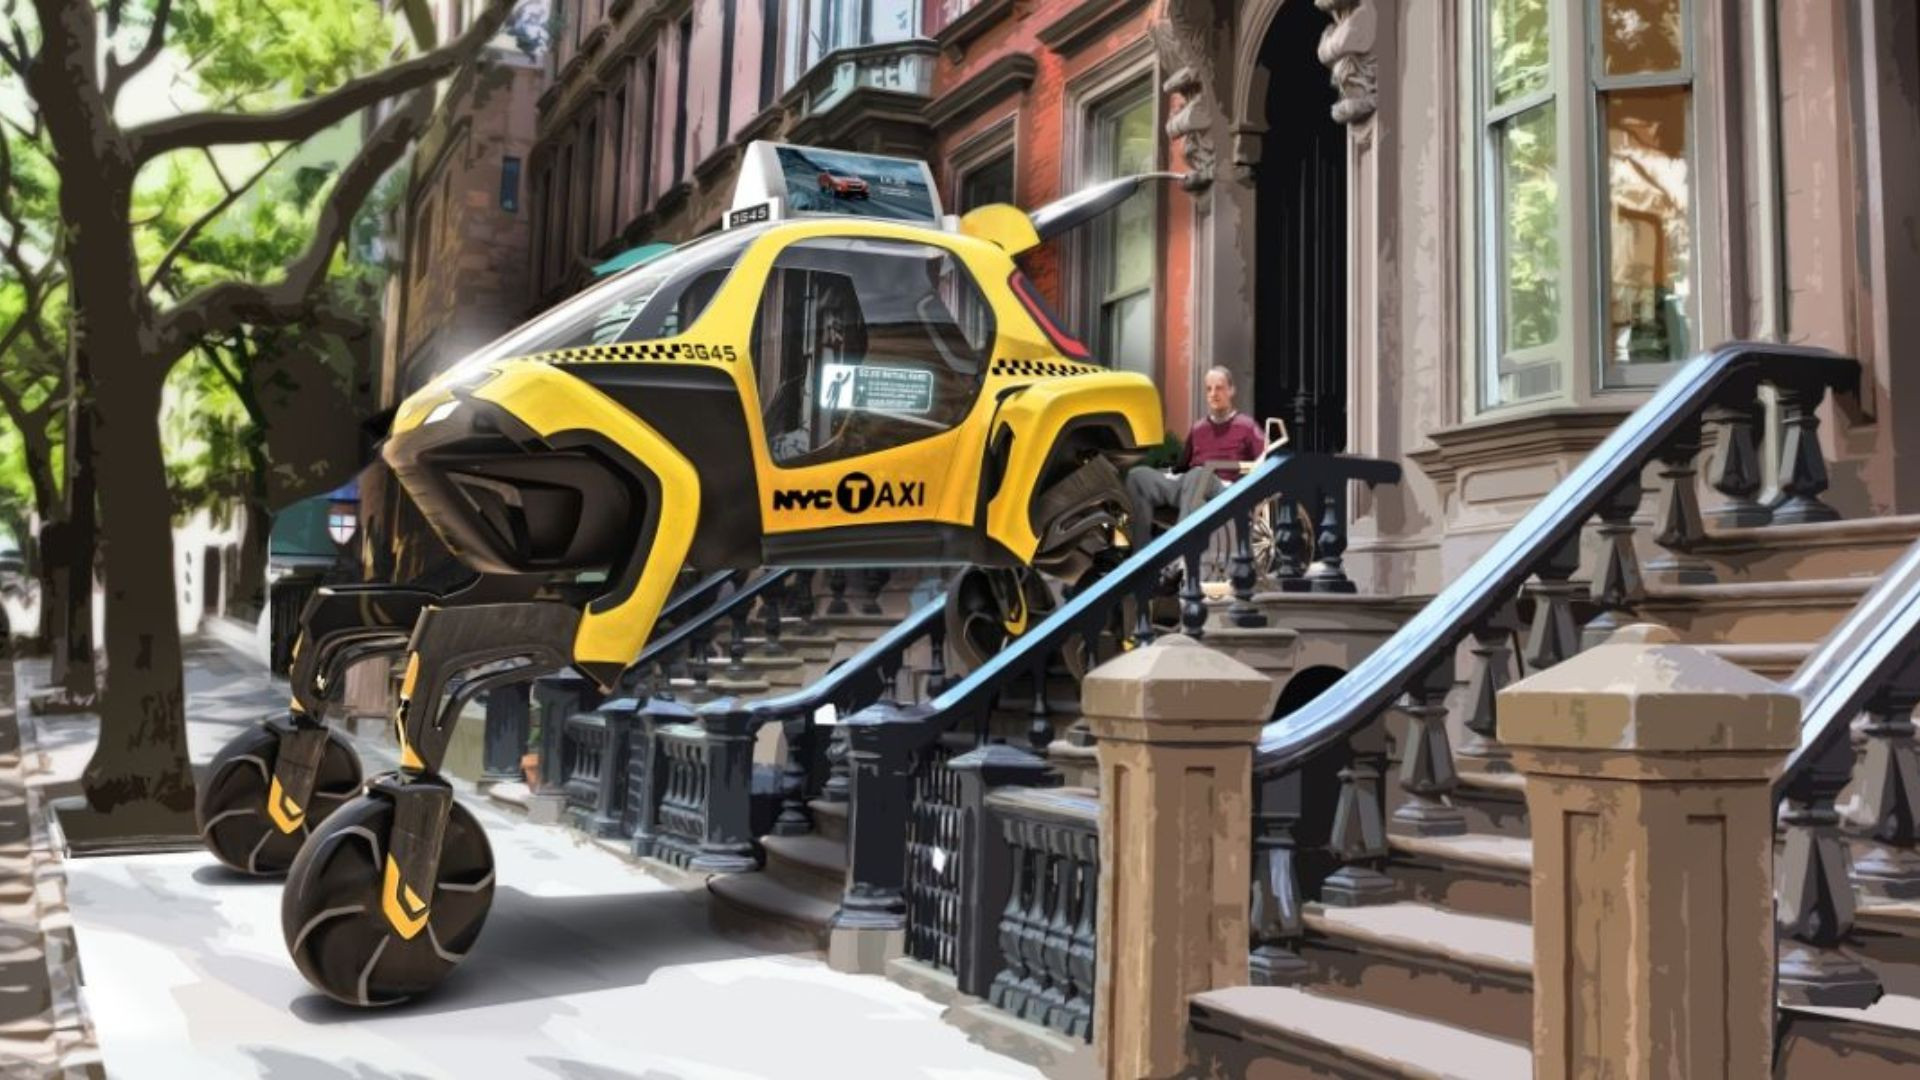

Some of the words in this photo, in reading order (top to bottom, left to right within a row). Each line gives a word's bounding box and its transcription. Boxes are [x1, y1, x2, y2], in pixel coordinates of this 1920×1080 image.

[681, 343, 738, 362] 3G45
[773, 489, 833, 511] NYC
[840, 476, 925, 511] TAXI
